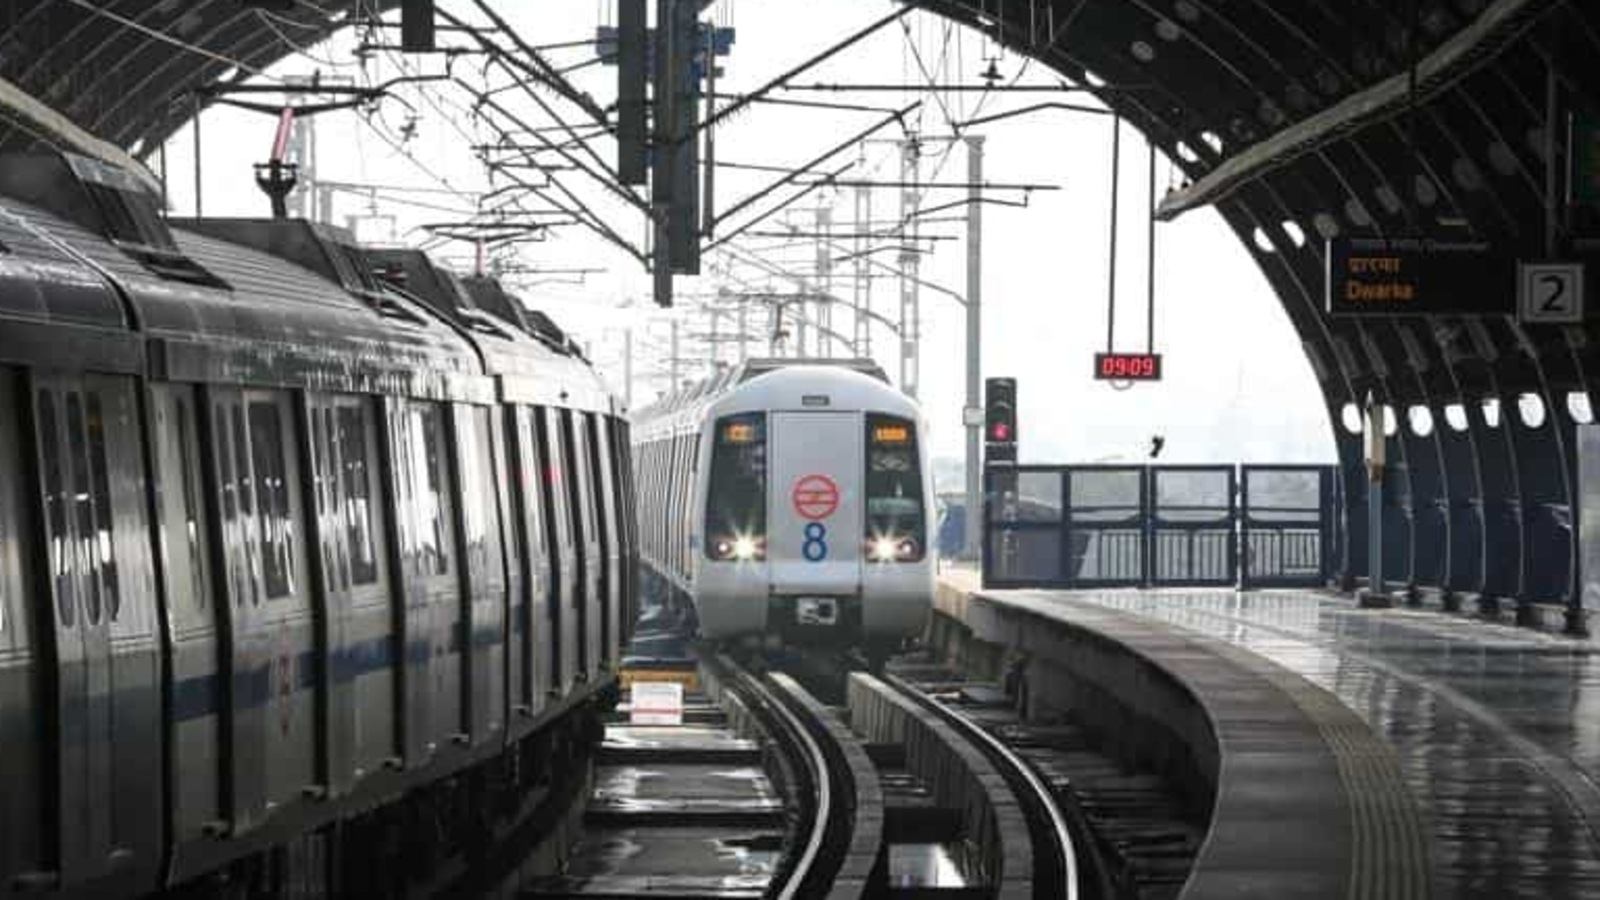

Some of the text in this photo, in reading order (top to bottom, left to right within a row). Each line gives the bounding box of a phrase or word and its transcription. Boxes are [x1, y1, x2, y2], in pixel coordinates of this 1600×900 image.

[1347, 280, 1414, 300] Dwarka
[1540, 274, 1565, 312] 2
[802, 522, 827, 562] 8
